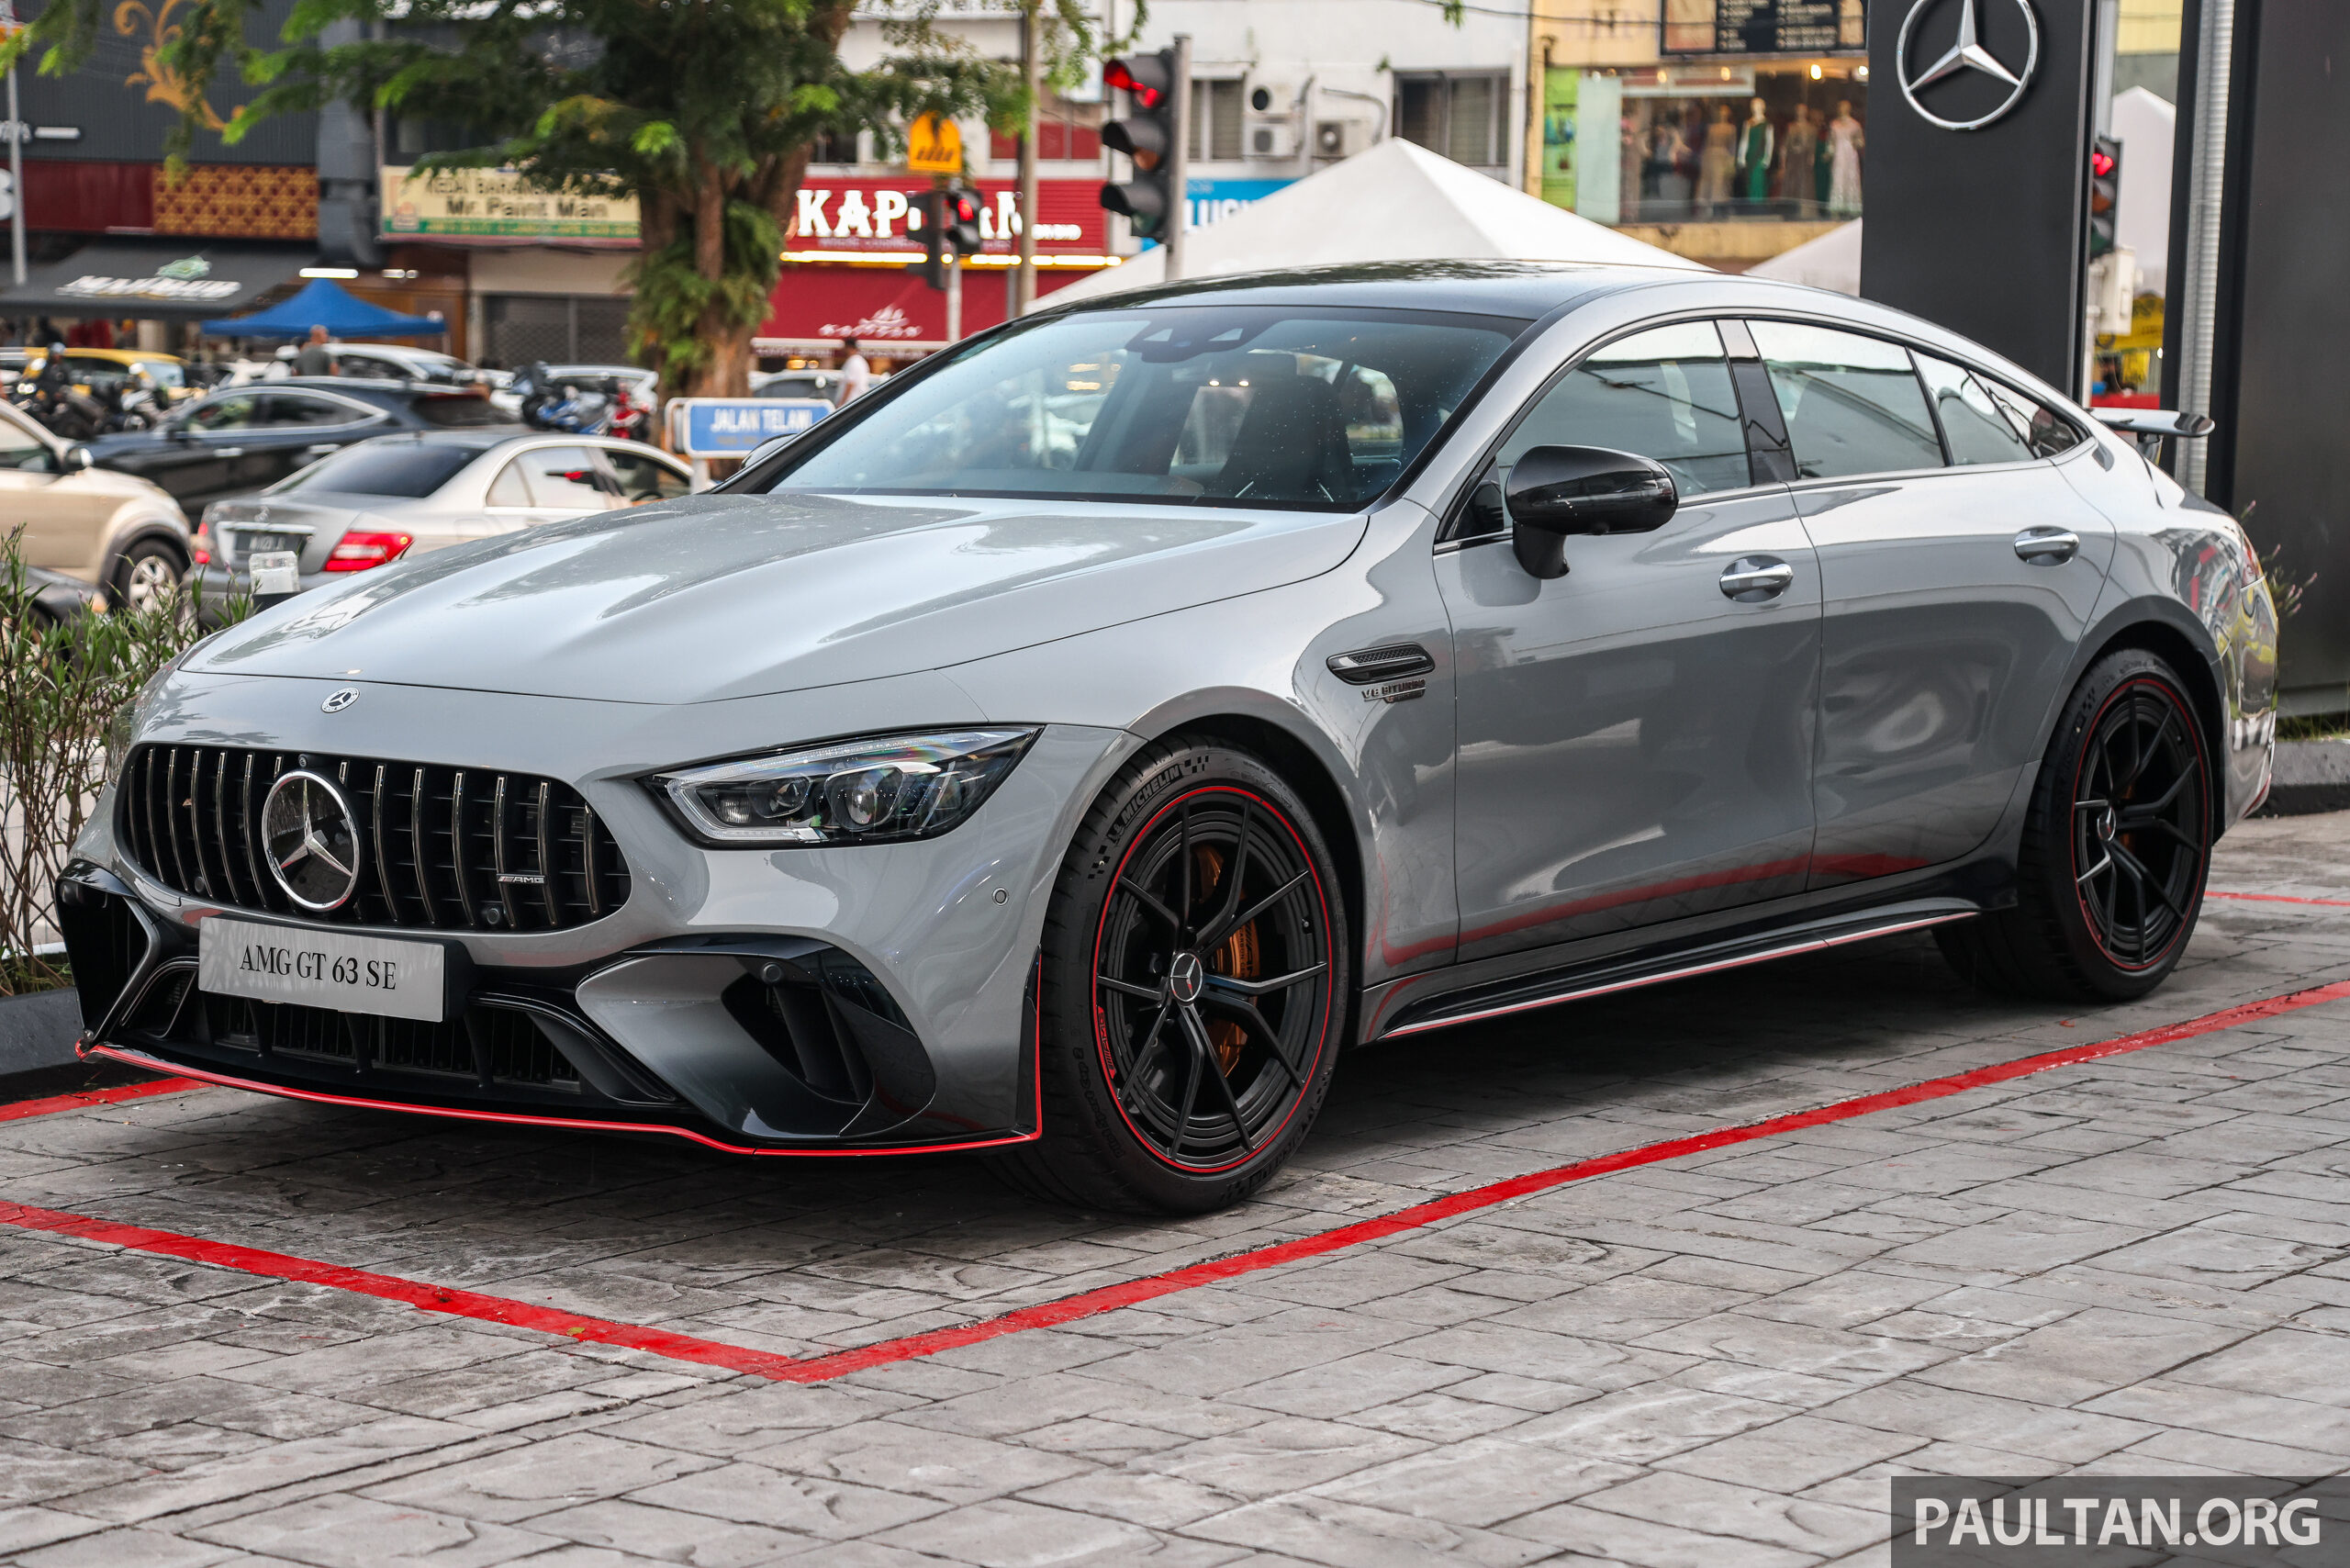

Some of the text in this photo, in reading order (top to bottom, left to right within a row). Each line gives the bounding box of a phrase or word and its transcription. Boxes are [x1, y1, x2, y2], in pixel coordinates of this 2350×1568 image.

[486, 196, 549, 218] Paint
[556, 196, 610, 218] Man
[710, 409, 760, 433] JALAN
[1361, 689, 1380, 700] V8
[1382, 678, 1427, 696] BITURBO
[1120, 764, 1183, 825] MICHELIN
[513, 876, 544, 884] AMG
[240, 944, 397, 991] AMG GT 63 SE
[1072, 1047, 1125, 1159] Pilot Sport Cup 2
